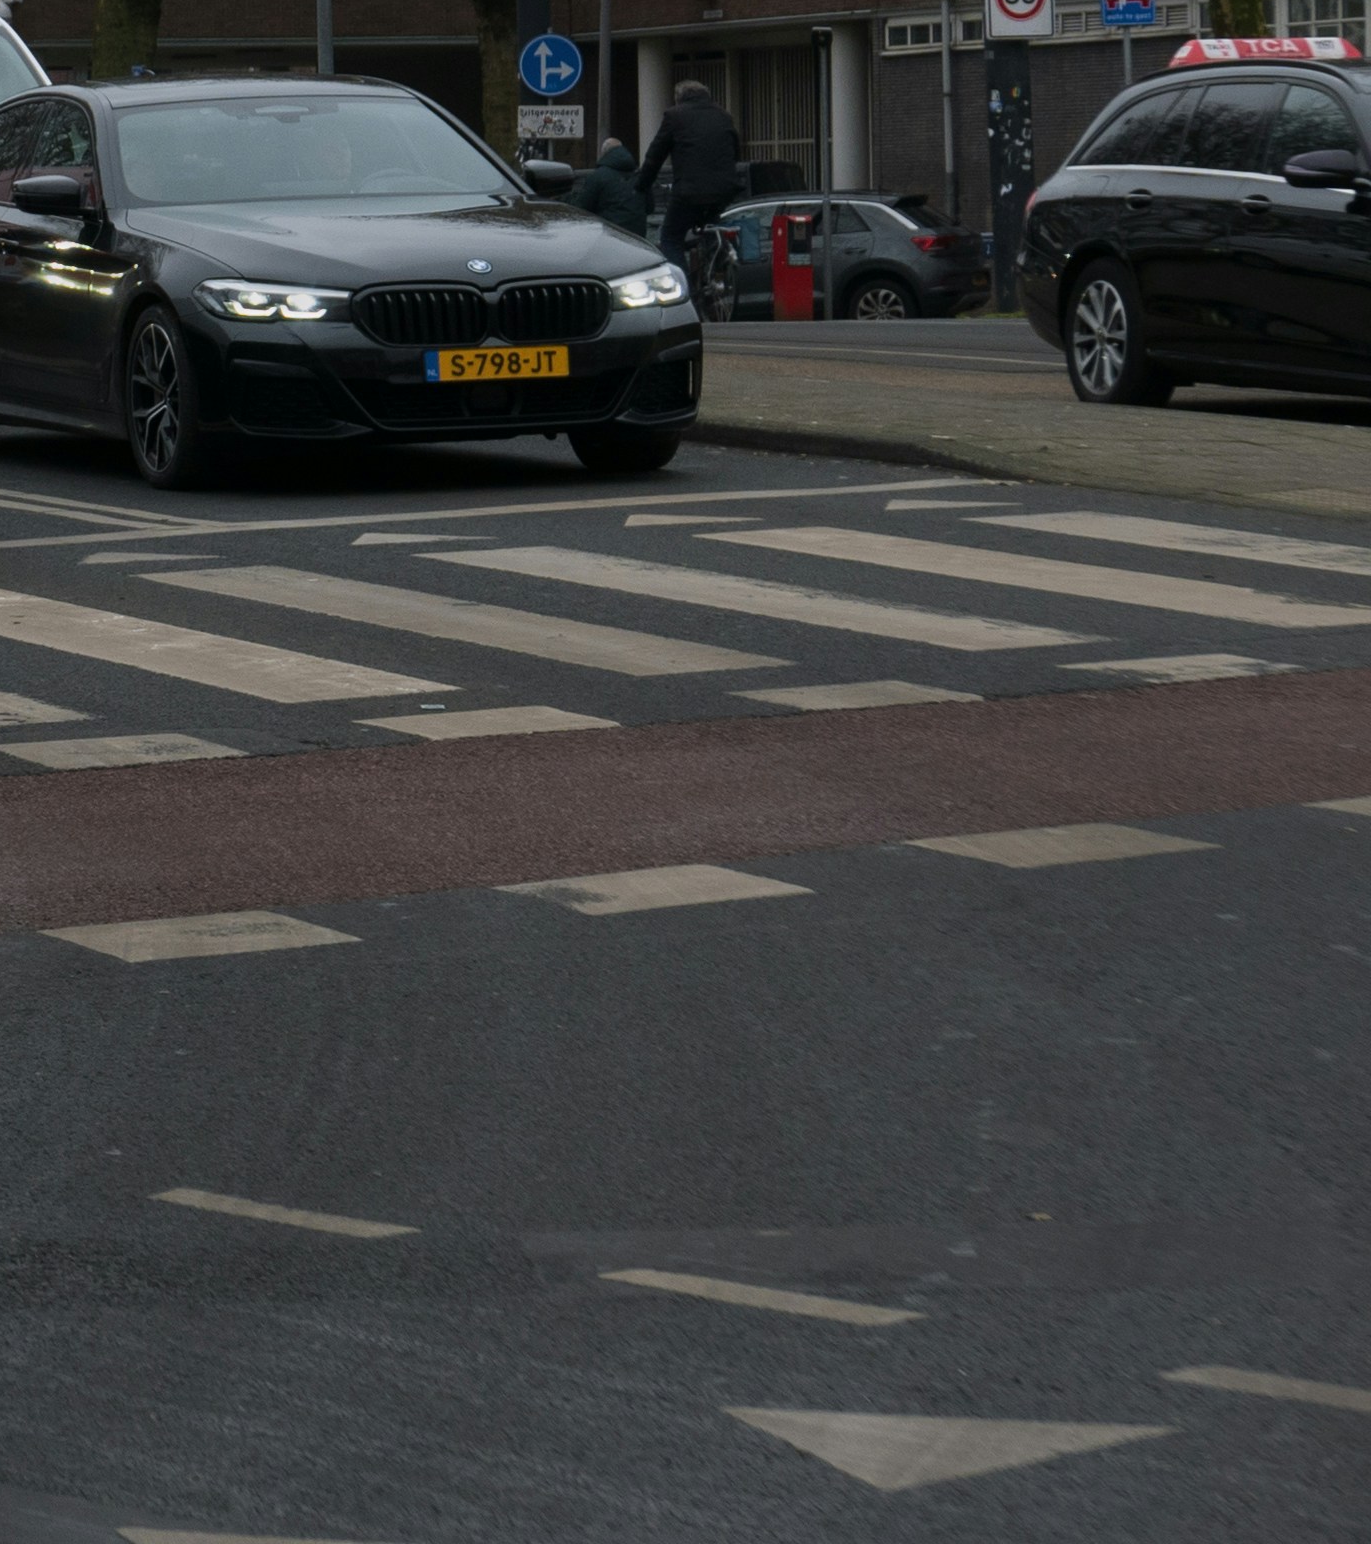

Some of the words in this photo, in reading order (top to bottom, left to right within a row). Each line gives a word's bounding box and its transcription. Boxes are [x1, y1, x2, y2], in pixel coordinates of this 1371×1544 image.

[1239, 38, 1300, 53] TCA
[427, 368, 439, 378] NL
[450, 350, 557, 377] S-798-JT
